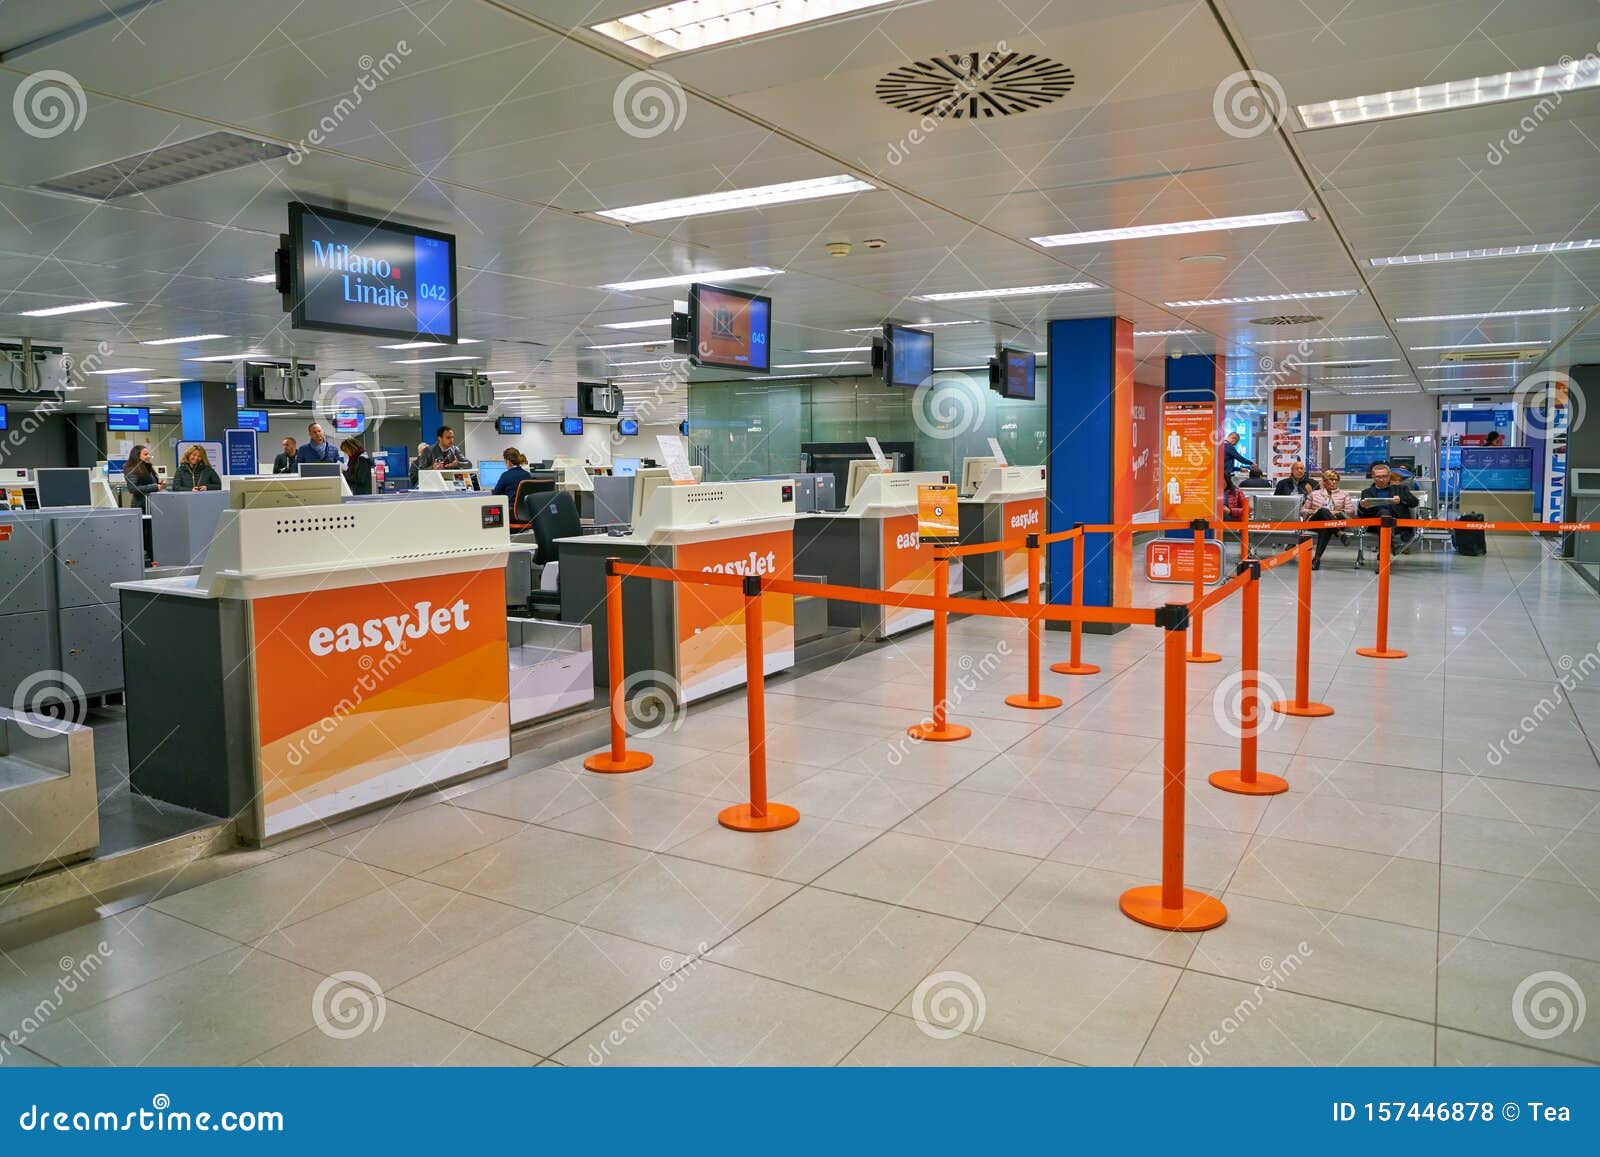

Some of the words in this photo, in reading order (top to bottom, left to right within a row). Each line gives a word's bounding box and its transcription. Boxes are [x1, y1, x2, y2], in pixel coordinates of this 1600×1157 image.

[312, 240, 391, 278] Milano
[342, 274, 409, 309] Linate
[420, 282, 447, 302] 042
[752, 332, 766, 345] 043
[1010, 508, 1039, 529] easyJet
[896, 530, 921, 550] easy
[308, 599, 471, 656] easyJet
